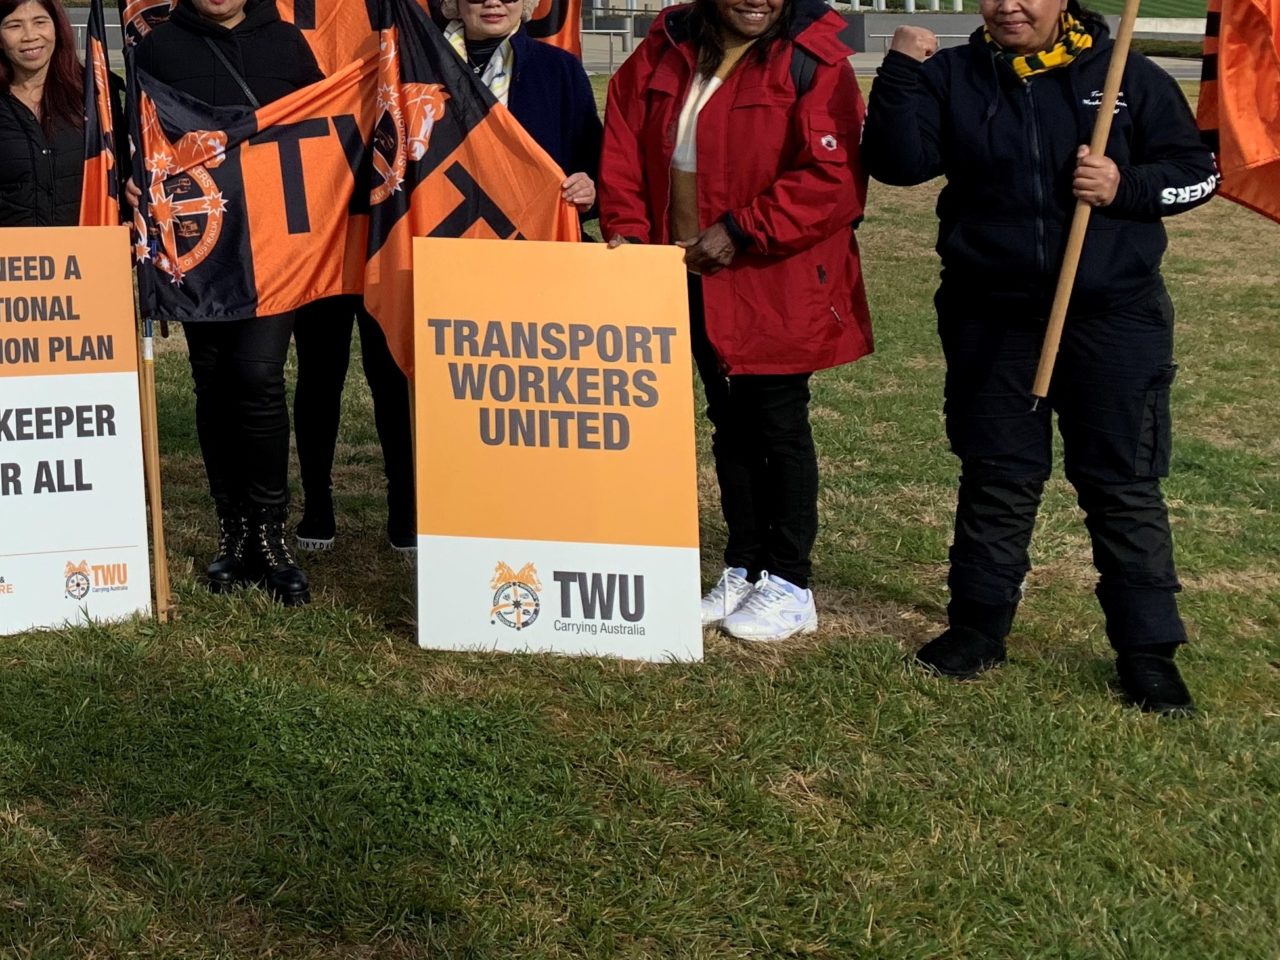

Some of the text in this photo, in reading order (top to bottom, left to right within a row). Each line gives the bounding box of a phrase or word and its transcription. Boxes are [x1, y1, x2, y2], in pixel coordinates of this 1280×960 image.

[194, 221, 218, 259] AUSTRALIA
[63, 254, 82, 281] A
[48, 334, 114, 363] PLAN
[427, 318, 677, 364] TRANSPORT
[447, 362, 659, 408] WORKERS
[479, 407, 631, 451] UNITED
[33, 458, 93, 494] ALL
[0, 576, 5, 584] &
[91, 563, 128, 586] TWU
[552, 570, 645, 623] TWU
[553, 619, 646, 636] Carrying Australia
